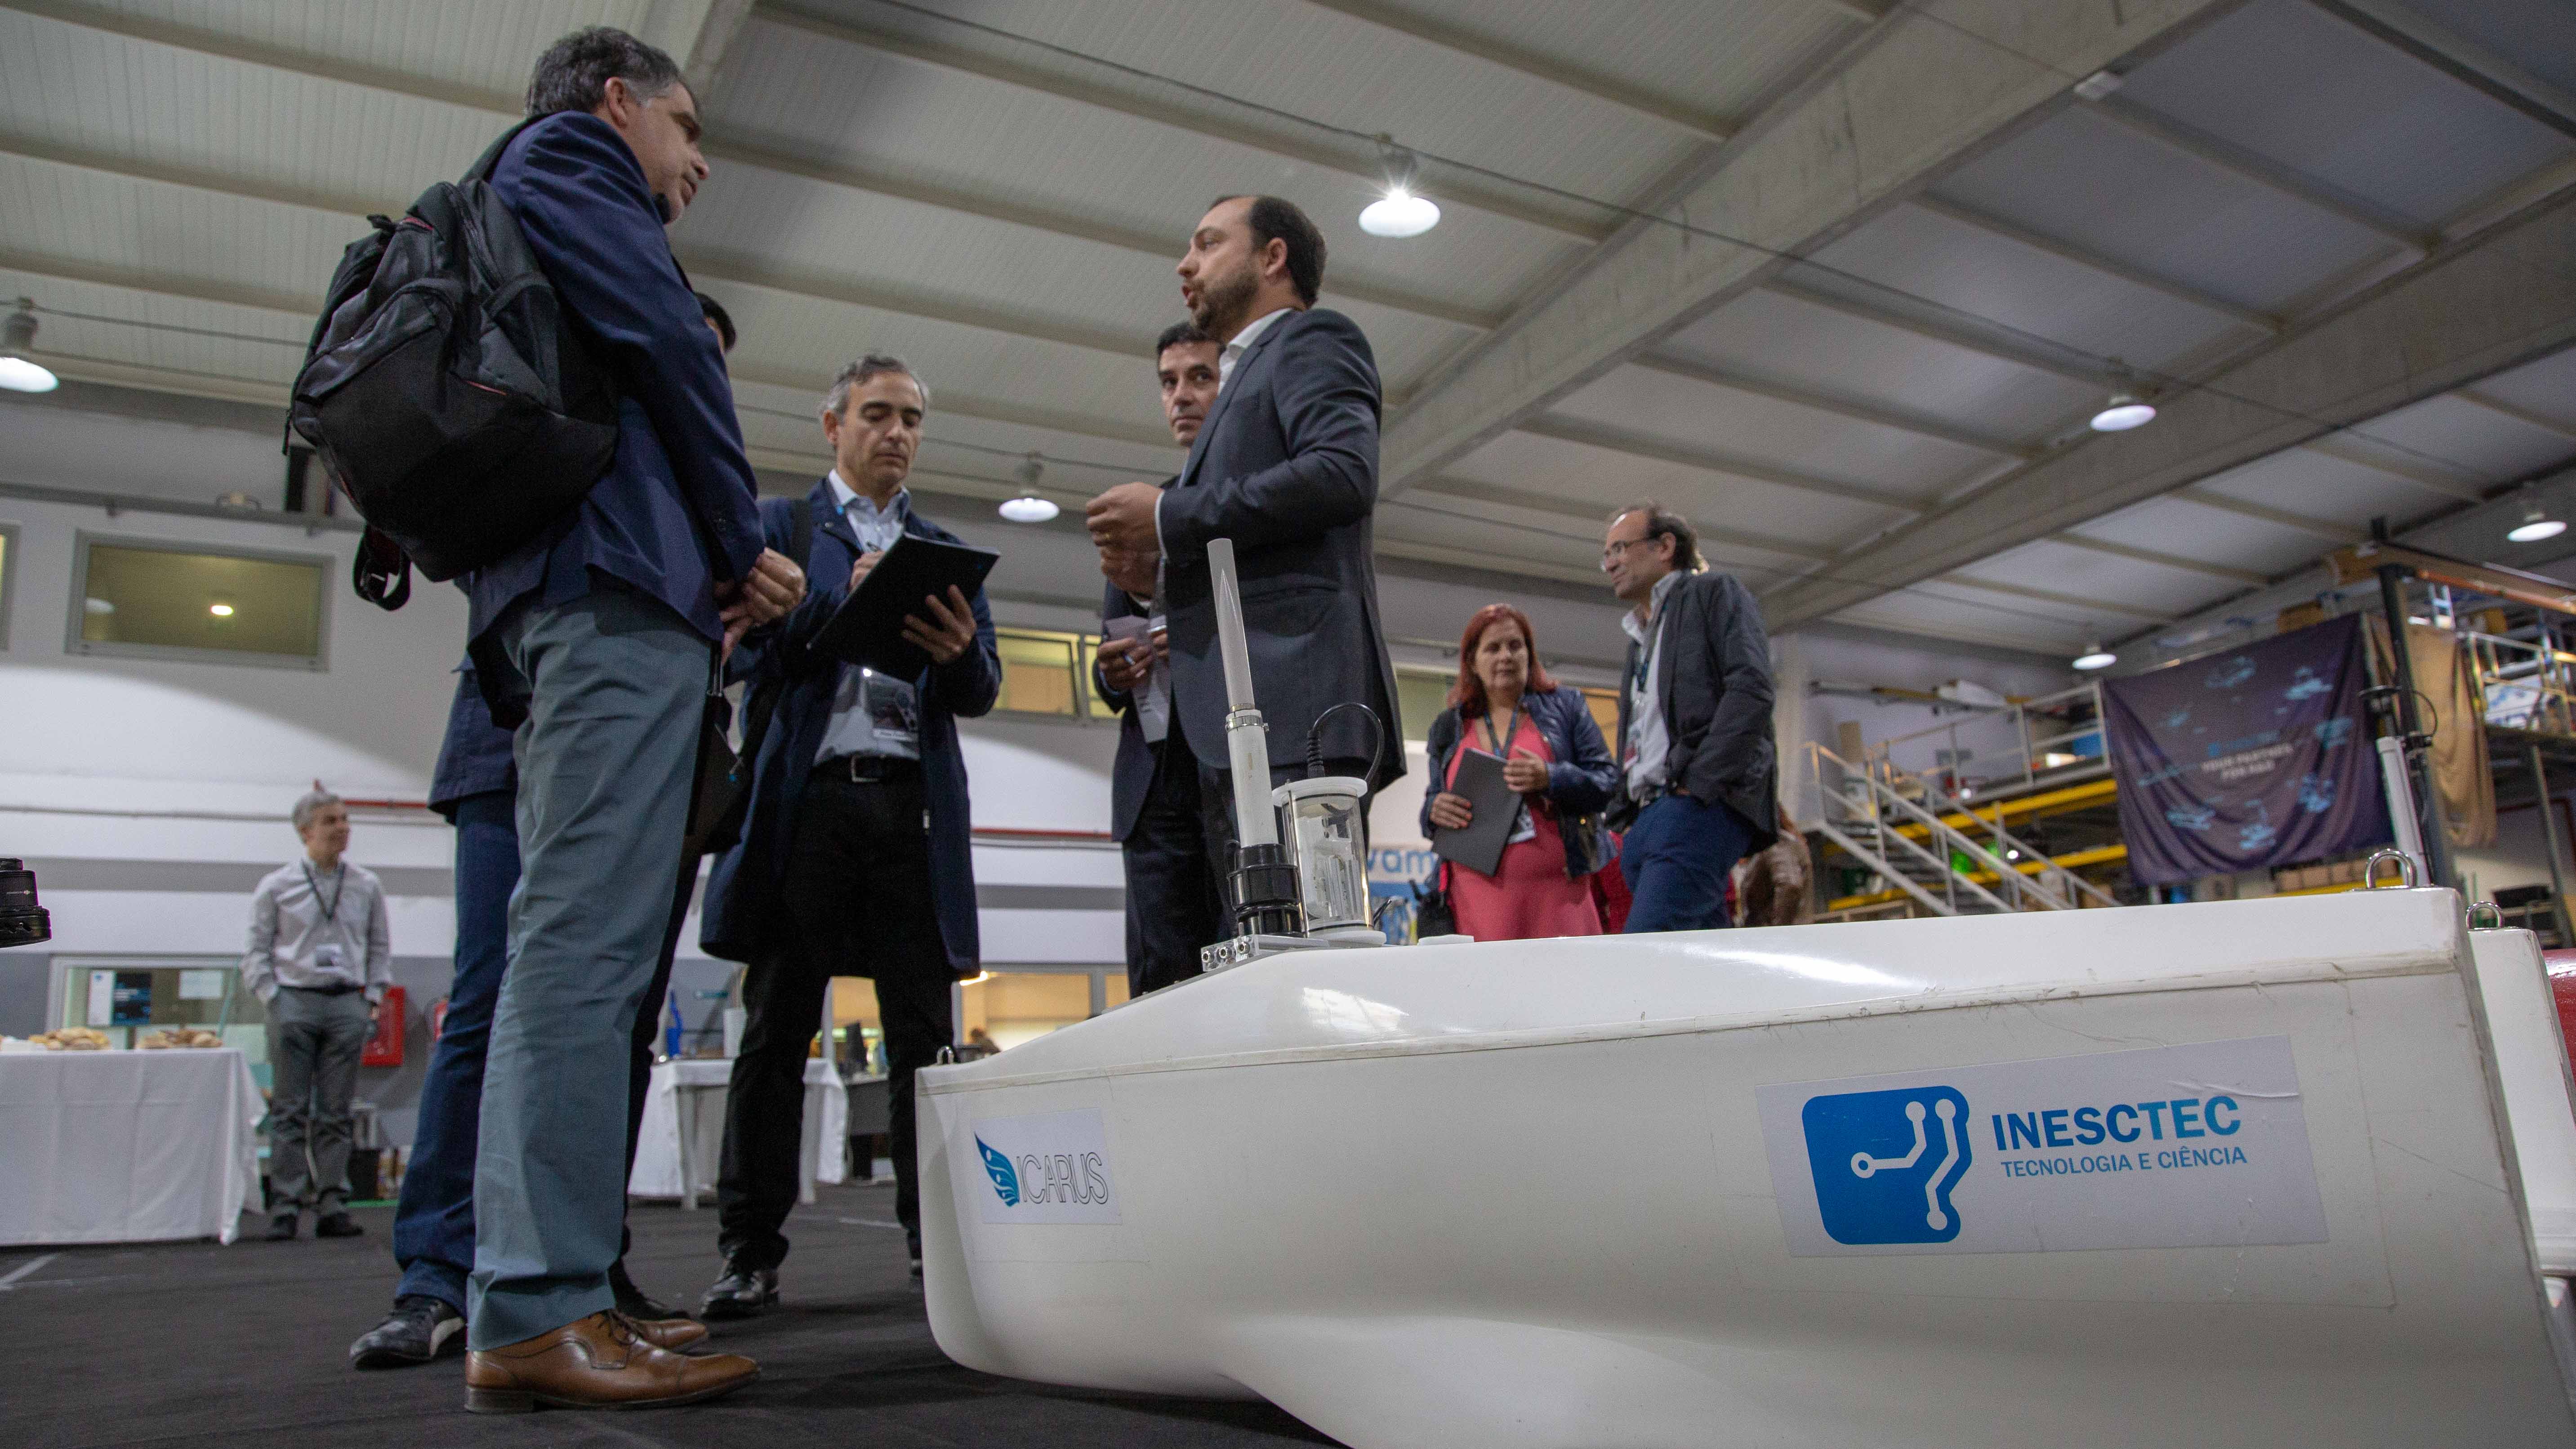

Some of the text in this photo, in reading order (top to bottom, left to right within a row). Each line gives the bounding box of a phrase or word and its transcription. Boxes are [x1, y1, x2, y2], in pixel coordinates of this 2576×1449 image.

[1016, 1152, 1108, 1204] ICARUS
[2001, 1146, 2247, 1177] TECNOLOGIA E CIÊNCIA
